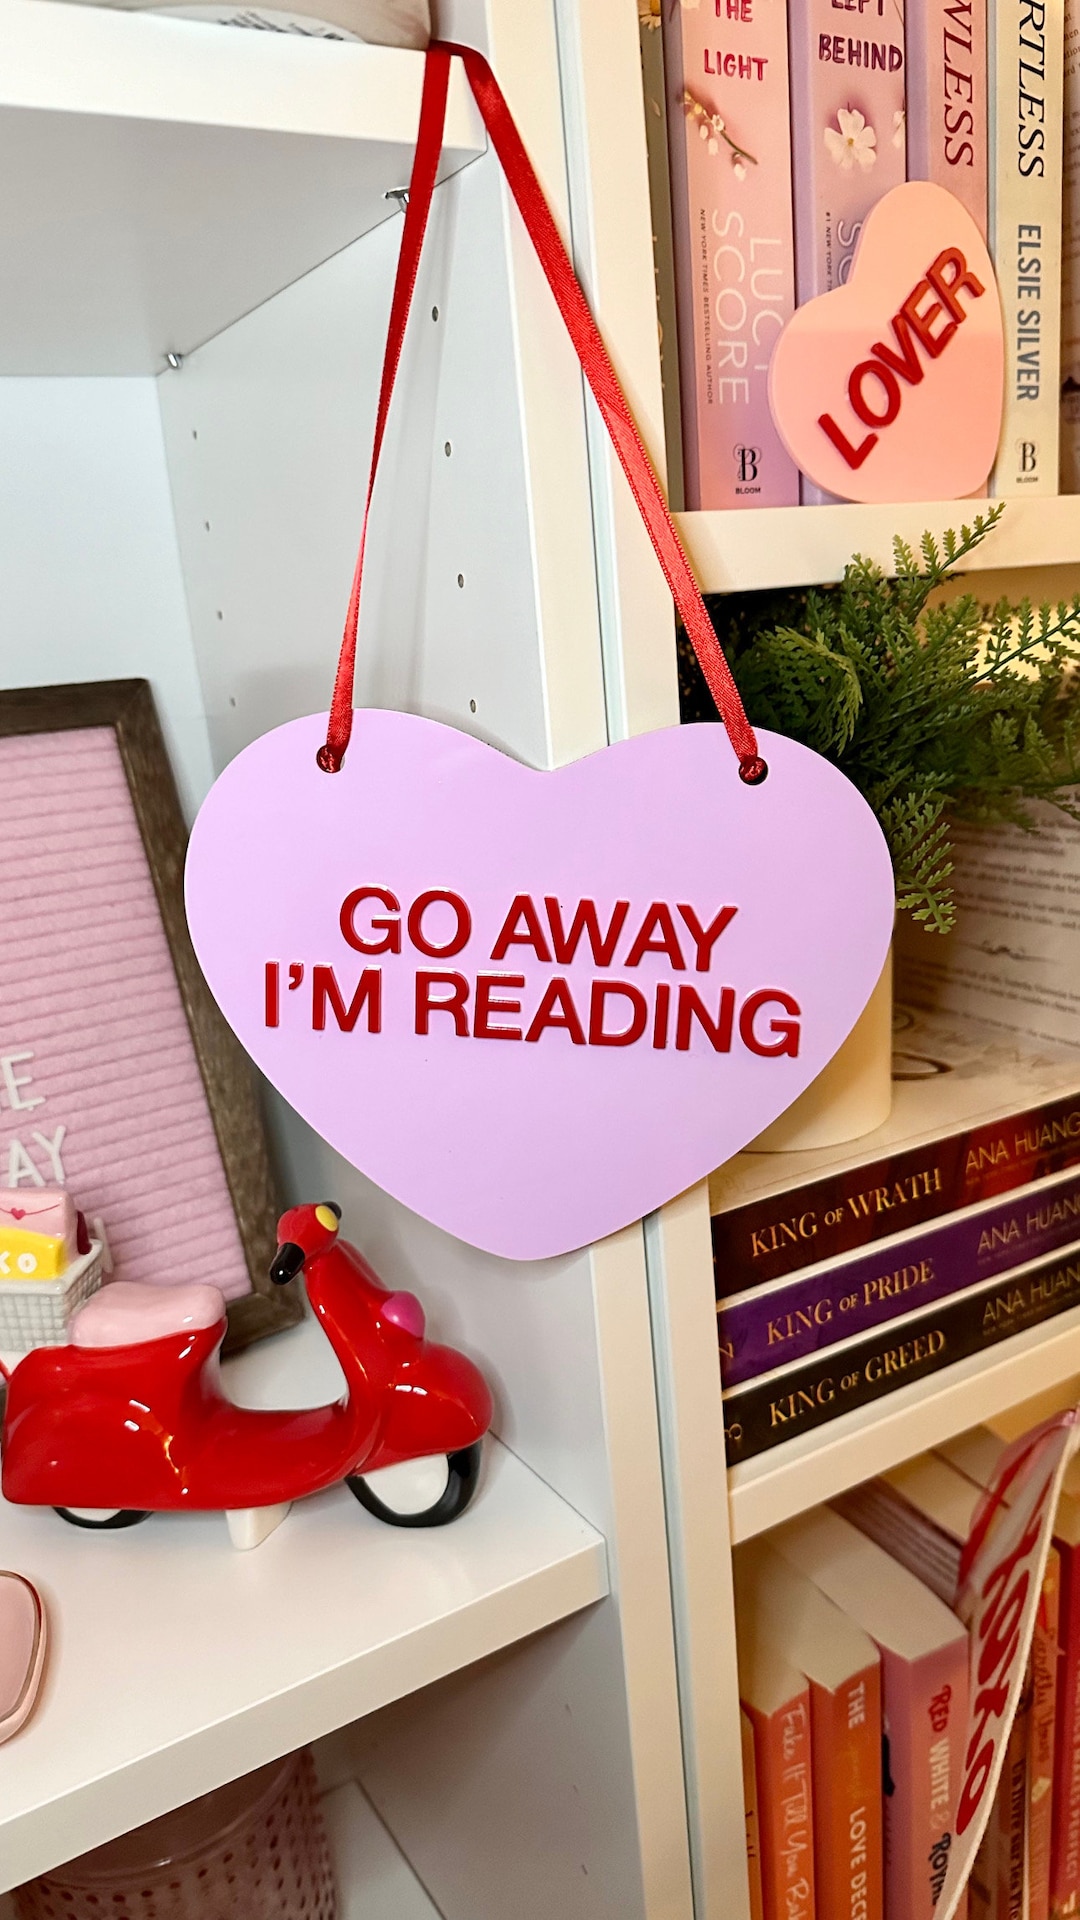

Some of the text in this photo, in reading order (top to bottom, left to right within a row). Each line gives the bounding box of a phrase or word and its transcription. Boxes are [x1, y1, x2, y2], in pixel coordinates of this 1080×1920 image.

[703, 48, 768, 81] LIGHT
[819, 33, 903, 72] BEHIND
[702, 264, 710, 294] TIMES
[712, 208, 750, 404] SCORE
[750, 236, 784, 371] LUC
[703, 297, 712, 361] BESTSELLING
[1016, 224, 1042, 401] ELSIE SILVER
[818, 246, 986, 470] LOVER
[735, 486, 761, 495] BLOOM
[339, 883, 737, 972] GO AWAY
[264, 960, 801, 1058] I’M READING
[965, 1138, 1010, 1174] ANA
[1015, 1110, 1080, 1156] HUANG
[750, 1211, 818, 1258] KING
[847, 1167, 943, 1222] WRATH
[977, 1218, 1021, 1256] ANA
[1027, 1192, 1080, 1235] HUAN
[766, 1298, 832, 1346] KING
[863, 1257, 936, 1306] PRIDE
[983, 1289, 1026, 1326] ANA
[767, 1377, 836, 1427] KING
[864, 1329, 946, 1383] GREED
[847, 1681, 866, 1730] THE
[927, 1683, 952, 1734] RED
[929, 1737, 950, 1811] WHITE
[780, 1829, 808, 1879] You
[849, 1805, 867, 1870] LOVE
